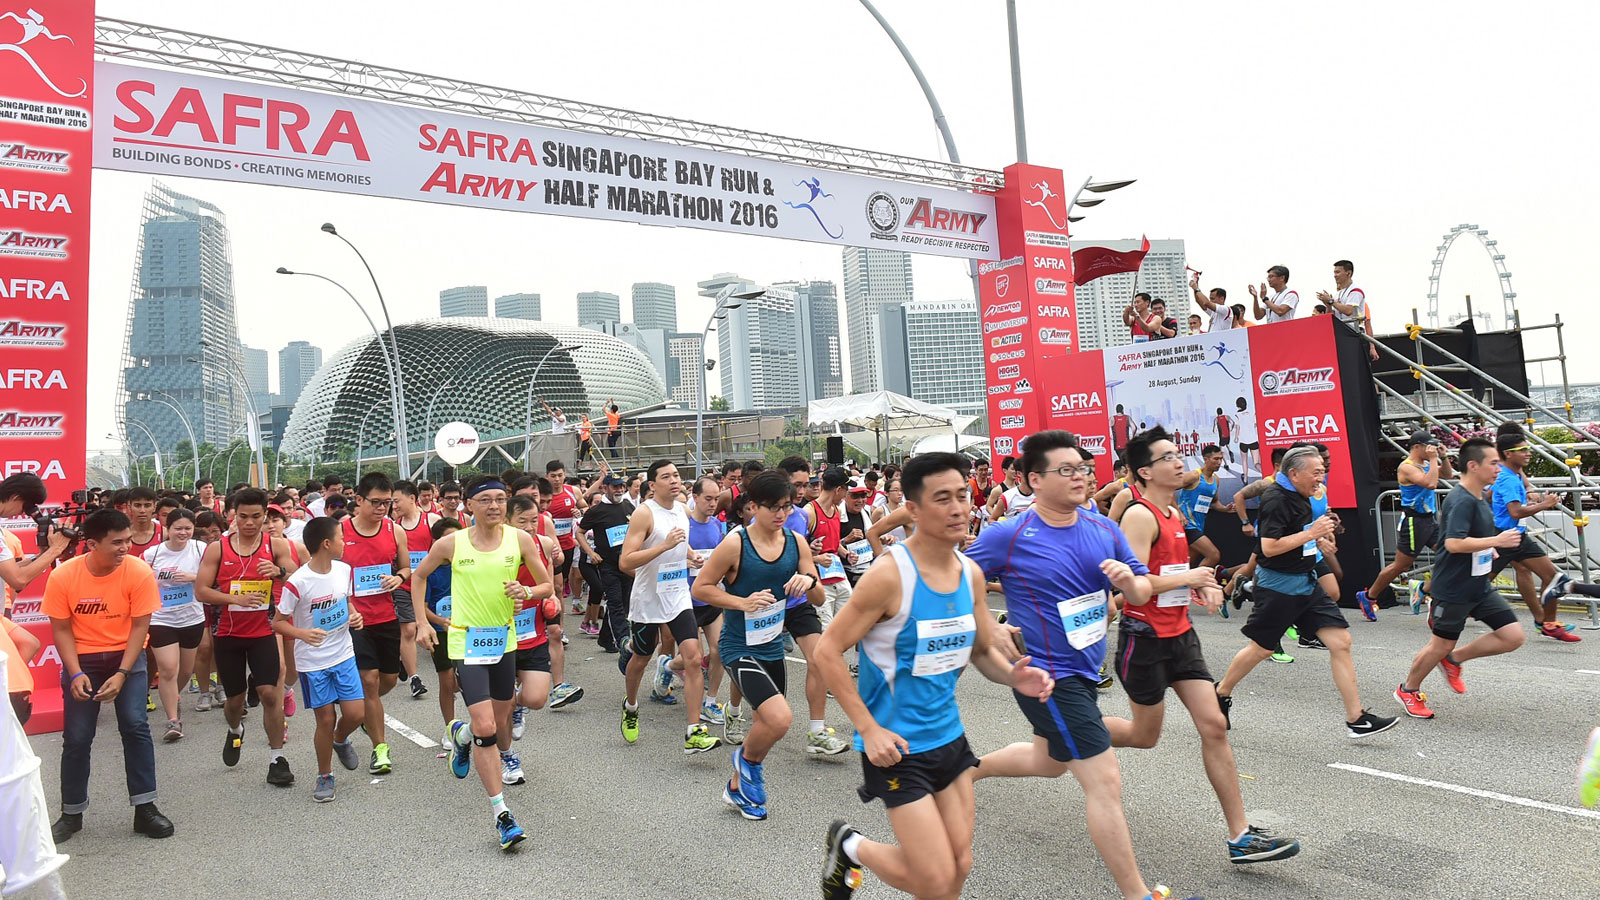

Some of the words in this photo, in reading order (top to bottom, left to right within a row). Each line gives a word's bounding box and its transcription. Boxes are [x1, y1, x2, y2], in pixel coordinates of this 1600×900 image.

[0, 100, 44, 113] SINGAPORE
[47, 106, 63, 115] BAY
[65, 109, 80, 118] RUN
[0, 111, 18, 119] HALF
[21, 113, 65, 125] MARATHON
[68, 118, 87, 128] 2016
[113, 80, 371, 162] SAFRA
[2, 144, 69, 163] ARMY
[419, 124, 538, 166] SAFRA
[542, 140, 668, 181] SINGAPORE
[675, 159, 715, 187] BAY
[721, 167, 759, 194] RUN
[763, 178, 774, 196] &
[112, 147, 181, 166] BUILDING
[184, 155, 232, 171] BONDS
[241, 162, 304, 178] CREATING
[307, 169, 371, 186] MEMORIES
[0, 188, 72, 214] AFRA
[420, 161, 538, 202] ARMY
[544, 178, 599, 208] HALF
[607, 185, 723, 222] MARATHON
[729, 199, 778, 229] 2016
[900, 197, 915, 206] OUR
[904, 197, 987, 236] ARMY
[1, 231, 67, 249] ARMY
[901, 235, 923, 245] READY
[924, 238, 953, 248] DECISIVE
[955, 242, 990, 252] RESPECTED
[1034, 256, 1066, 270] SAFRA
[0, 278, 70, 301] FRA
[1038, 305, 1070, 318] SAFRA
[0, 321, 64, 337] ARMY
[1001, 334, 1021, 345] ACTIVE
[1118, 352, 1142, 362] SAFRA
[1143, 349, 1173, 359] SINGAPORE
[1174, 346, 1186, 354] BAY
[1187, 344, 1199, 352] RUN
[1120, 362, 1142, 372] ARMY
[1143, 360, 1156, 368] HALF
[1158, 356, 1189, 366] MARATHON
[1190, 353, 1205, 362] 2016
[0, 369, 68, 389] FRA
[1149, 380, 1155, 388] 28
[1157, 378, 1178, 388] August,
[1179, 375, 1201, 384] Sunday
[1282, 369, 1332, 385] ARMY
[989, 385, 1010, 393] SONY
[1051, 391, 1102, 411] SAFRA
[0, 412, 62, 427] ARMY
[1264, 414, 1340, 437] SAFRA
[360, 573, 385, 583] 8256
[163, 591, 188, 601] 82204
[12, 602, 41, 614] RM
[74, 603, 101, 614] RUN
[320, 608, 345, 625] 83385
[754, 614, 781, 629] 80467
[473, 638, 504, 647] 86836
[927, 635, 966, 652] 80449
